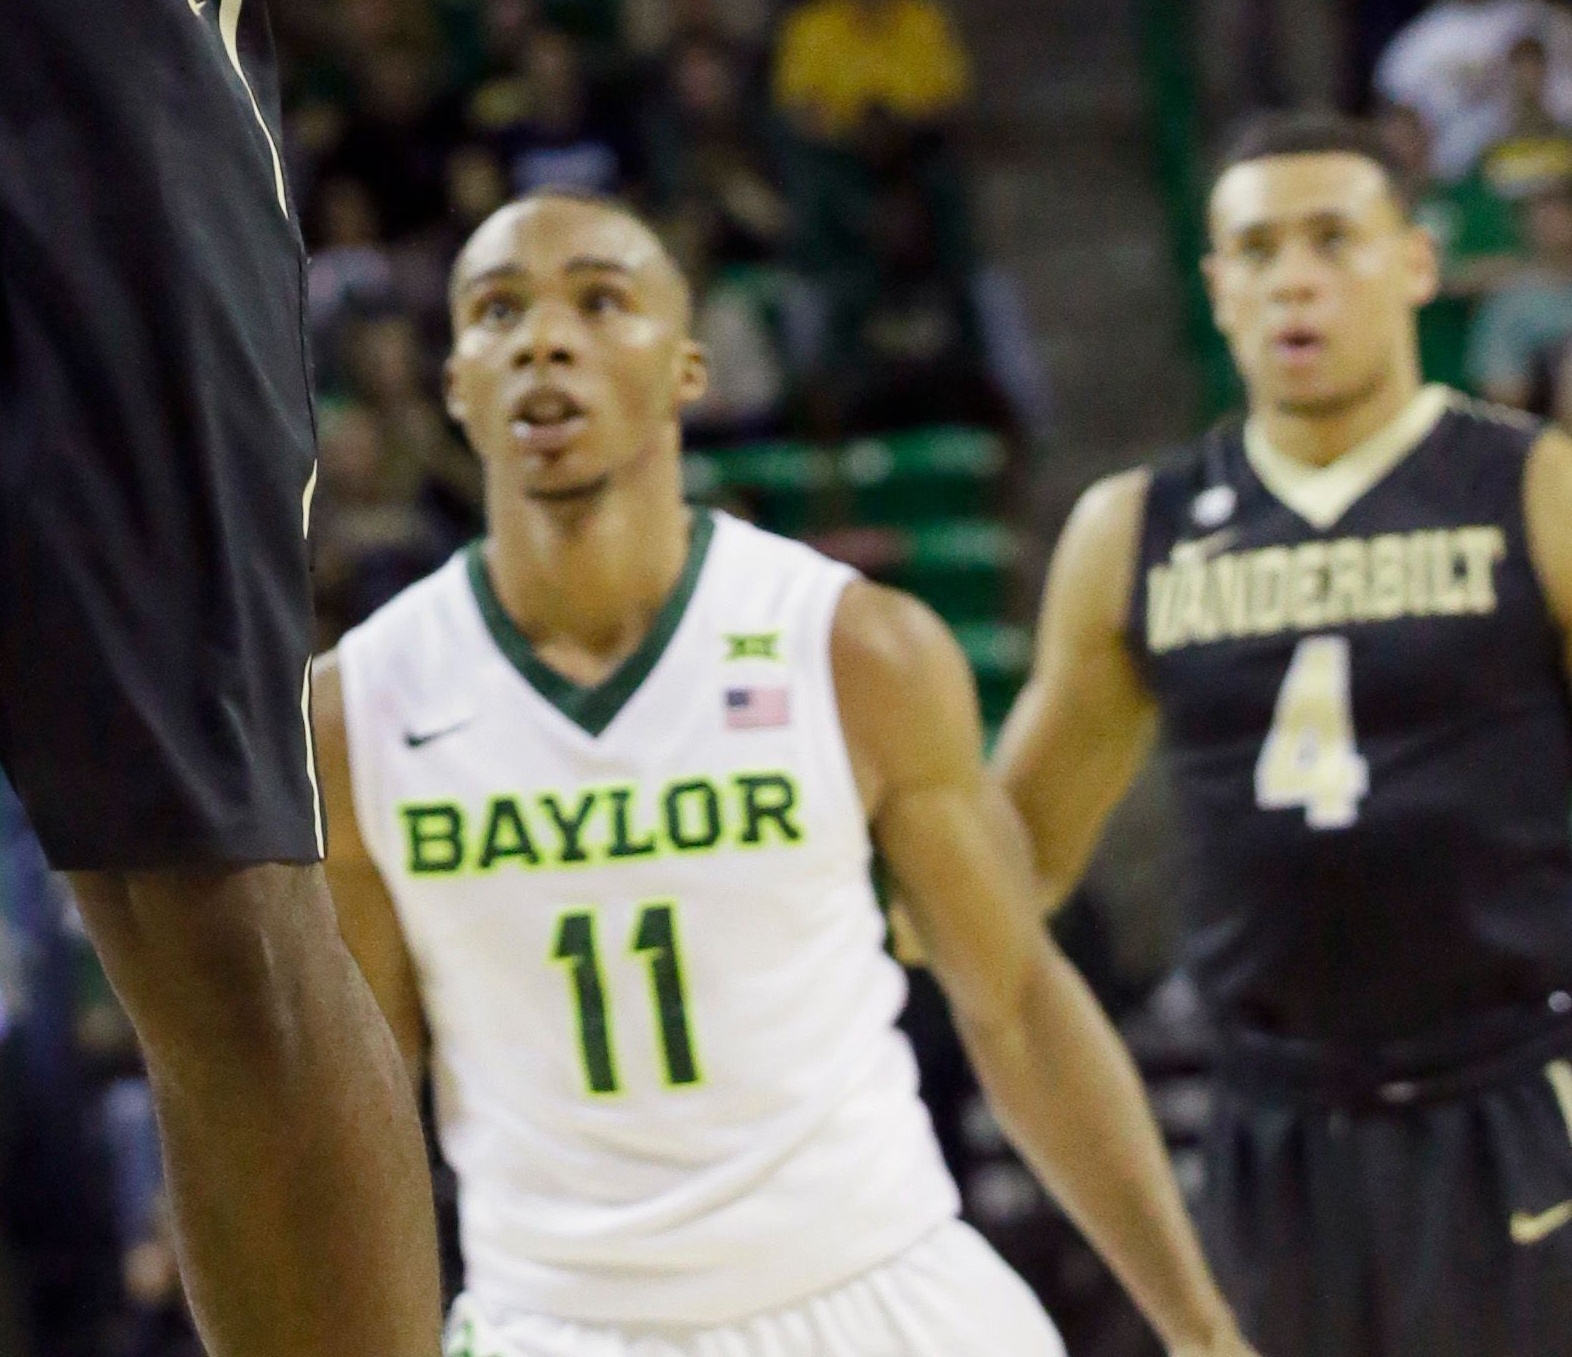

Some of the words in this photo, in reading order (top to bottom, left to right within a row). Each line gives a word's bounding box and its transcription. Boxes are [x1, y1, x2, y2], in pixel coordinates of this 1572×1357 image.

[1147, 525, 1506, 655] VANDERBILT
[1254, 634, 1370, 830] 4
[398, 770, 804, 878] BAYLOR
[548, 899, 704, 1095] 11
